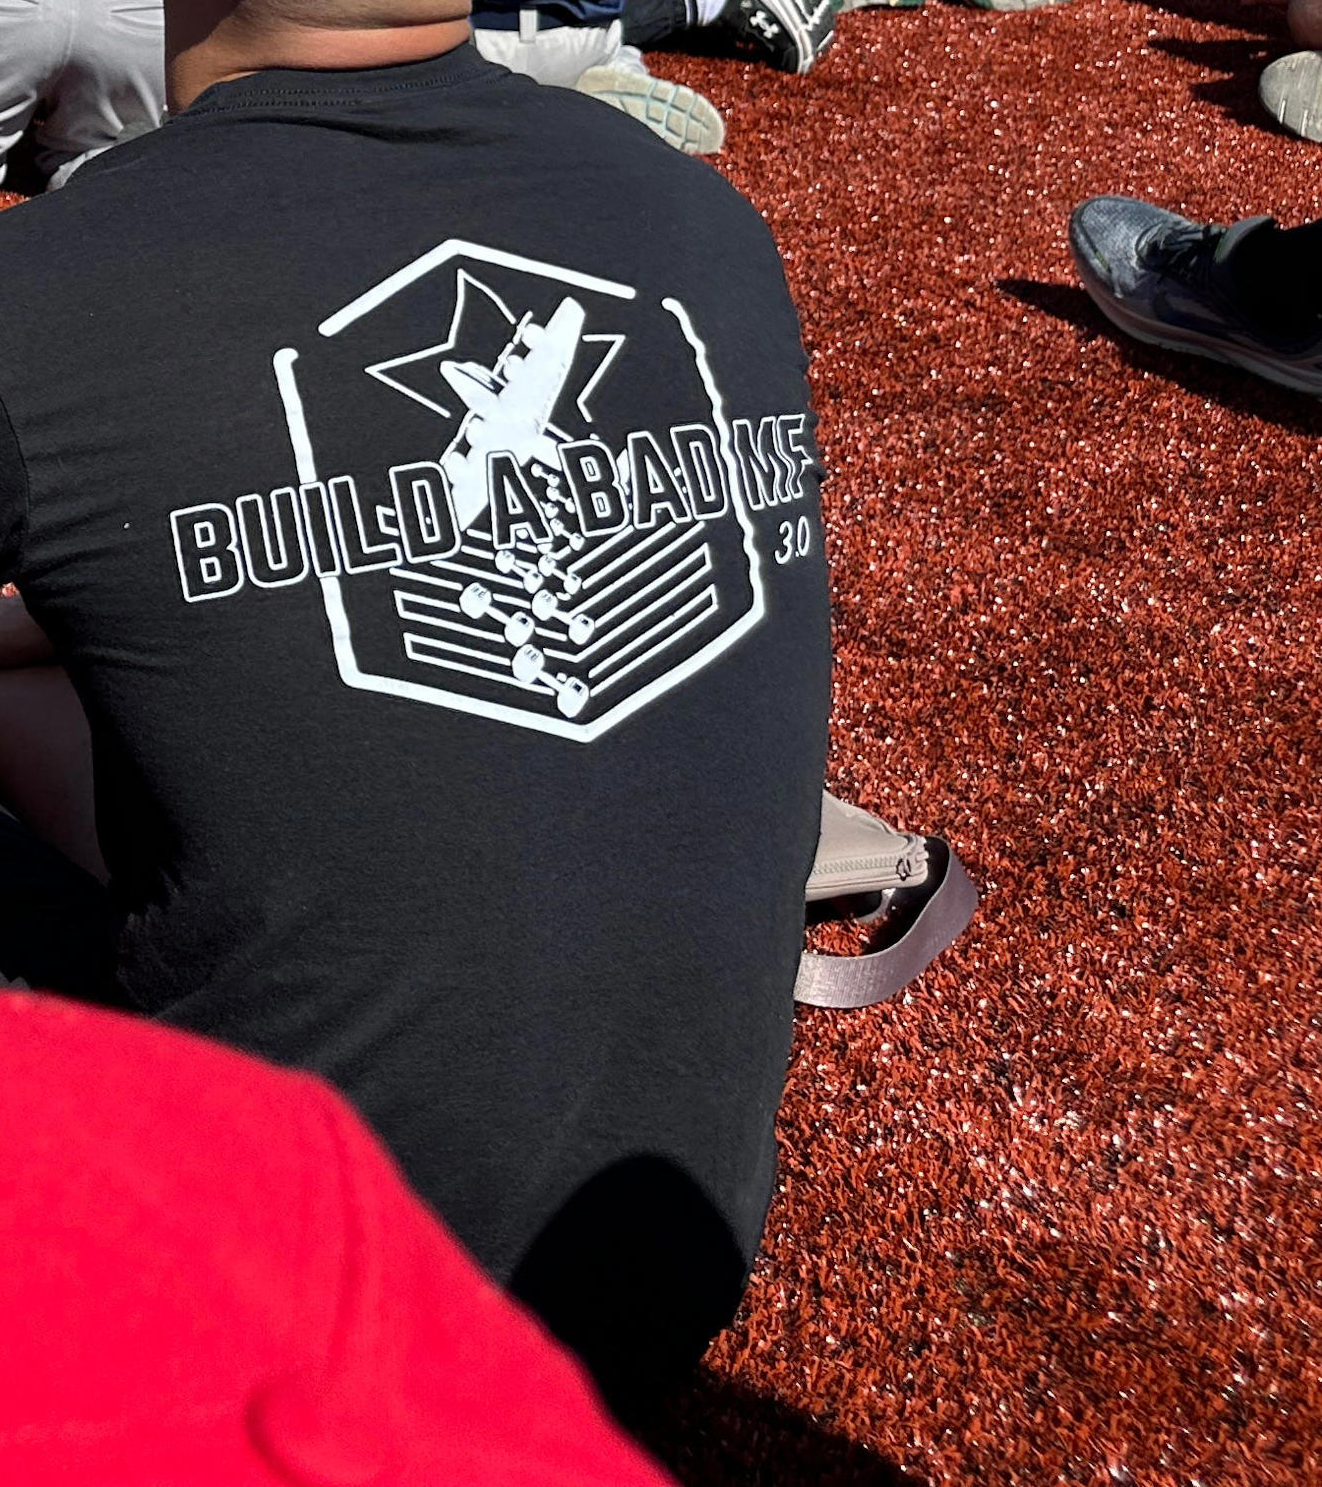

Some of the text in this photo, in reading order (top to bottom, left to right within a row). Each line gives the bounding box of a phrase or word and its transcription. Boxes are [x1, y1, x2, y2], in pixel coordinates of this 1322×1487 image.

[169, 413, 814, 602] BUILD A BAD MF
[774, 516, 813, 565] 3.0
